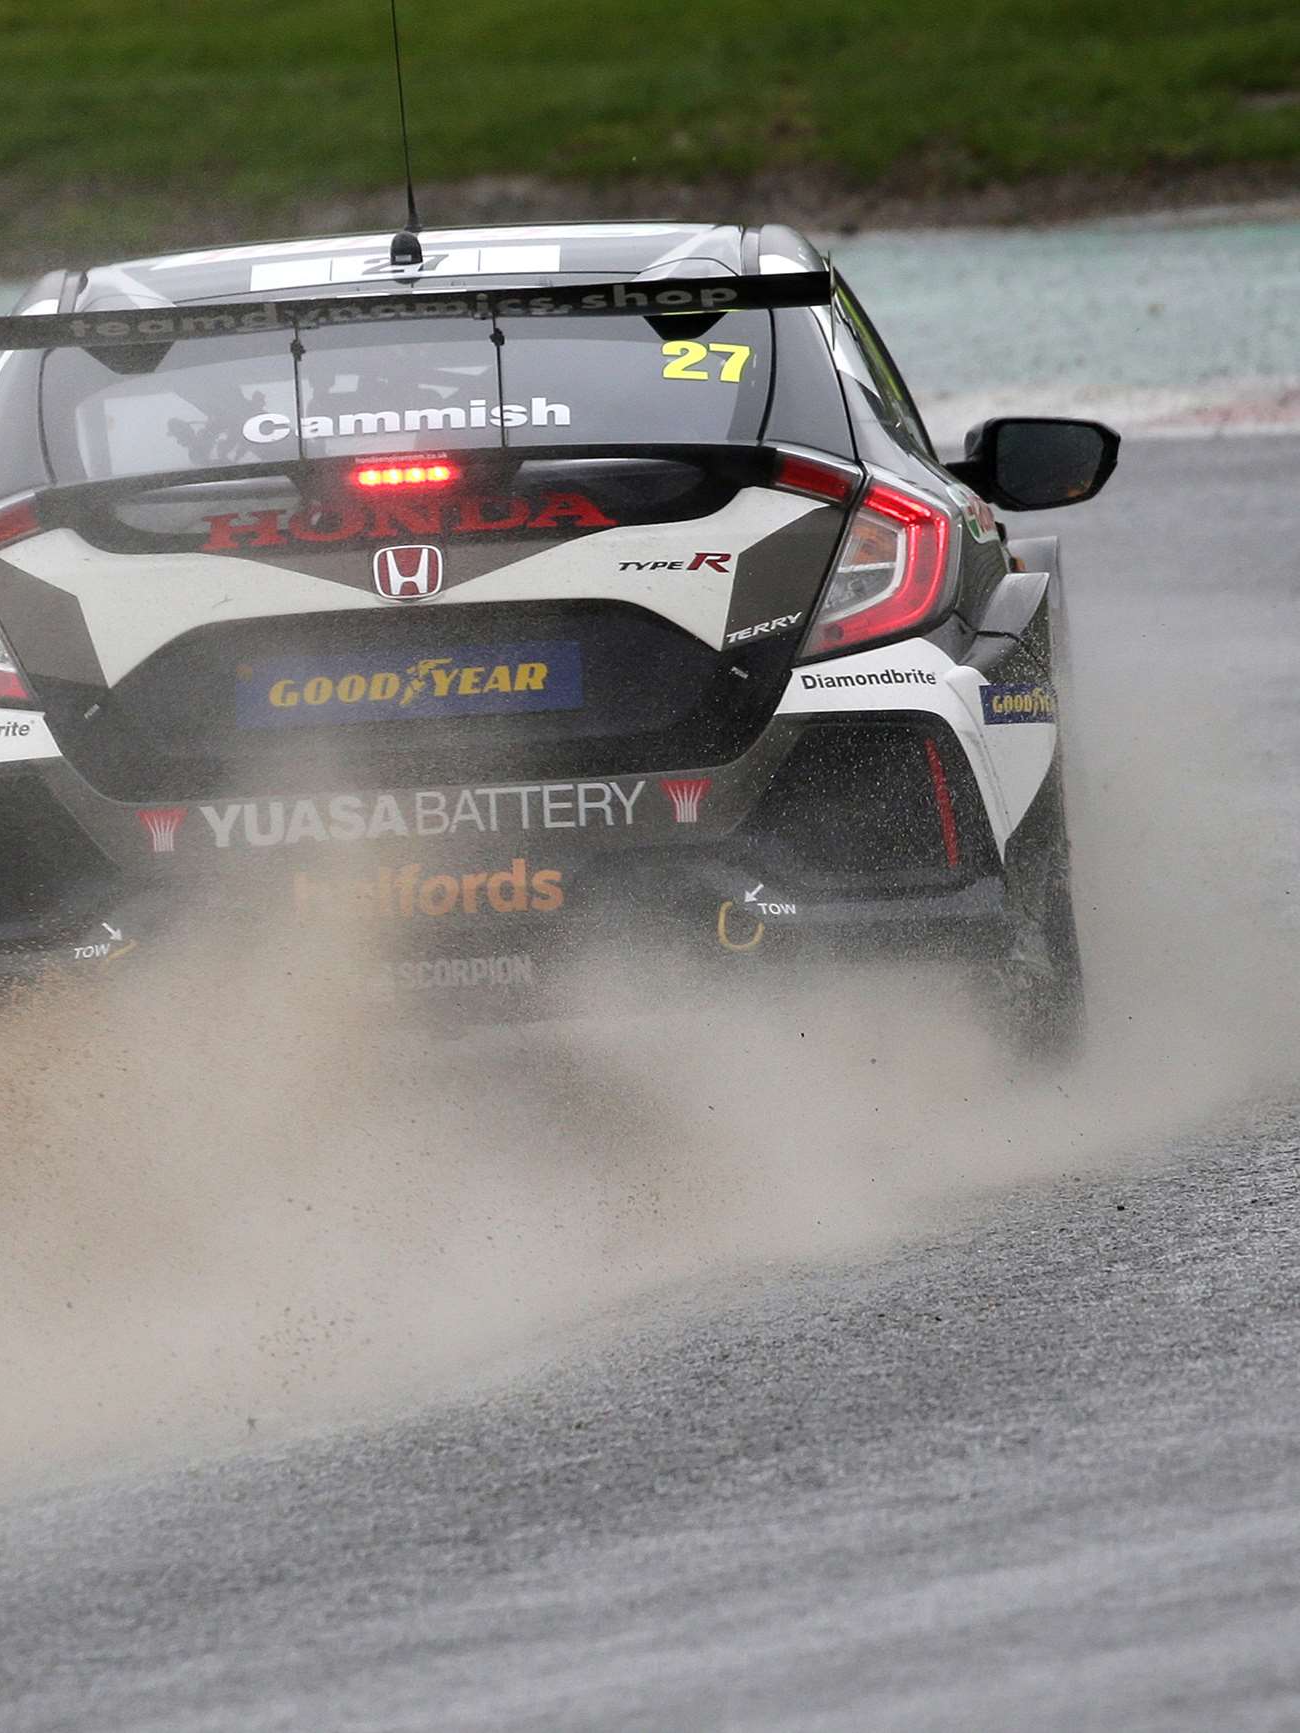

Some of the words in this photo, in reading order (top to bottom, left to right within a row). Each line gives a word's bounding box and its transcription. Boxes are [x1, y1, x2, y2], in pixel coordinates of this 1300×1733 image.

[661, 340, 751, 384] 27
[242, 397, 572, 443] Cammish
[202, 492, 619, 551] HONDA
[618, 560, 684, 571] TYPE
[686, 552, 732, 573] R
[726, 611, 802, 644] TERRY
[268, 658, 550, 708] GOODYEAR
[800, 669, 937, 690] Diamondbrite
[293, 858, 565, 918] lfords
[757, 903, 797, 915] TOW
[74, 943, 110, 959] TOW
[399, 954, 536, 988] SCORPION
